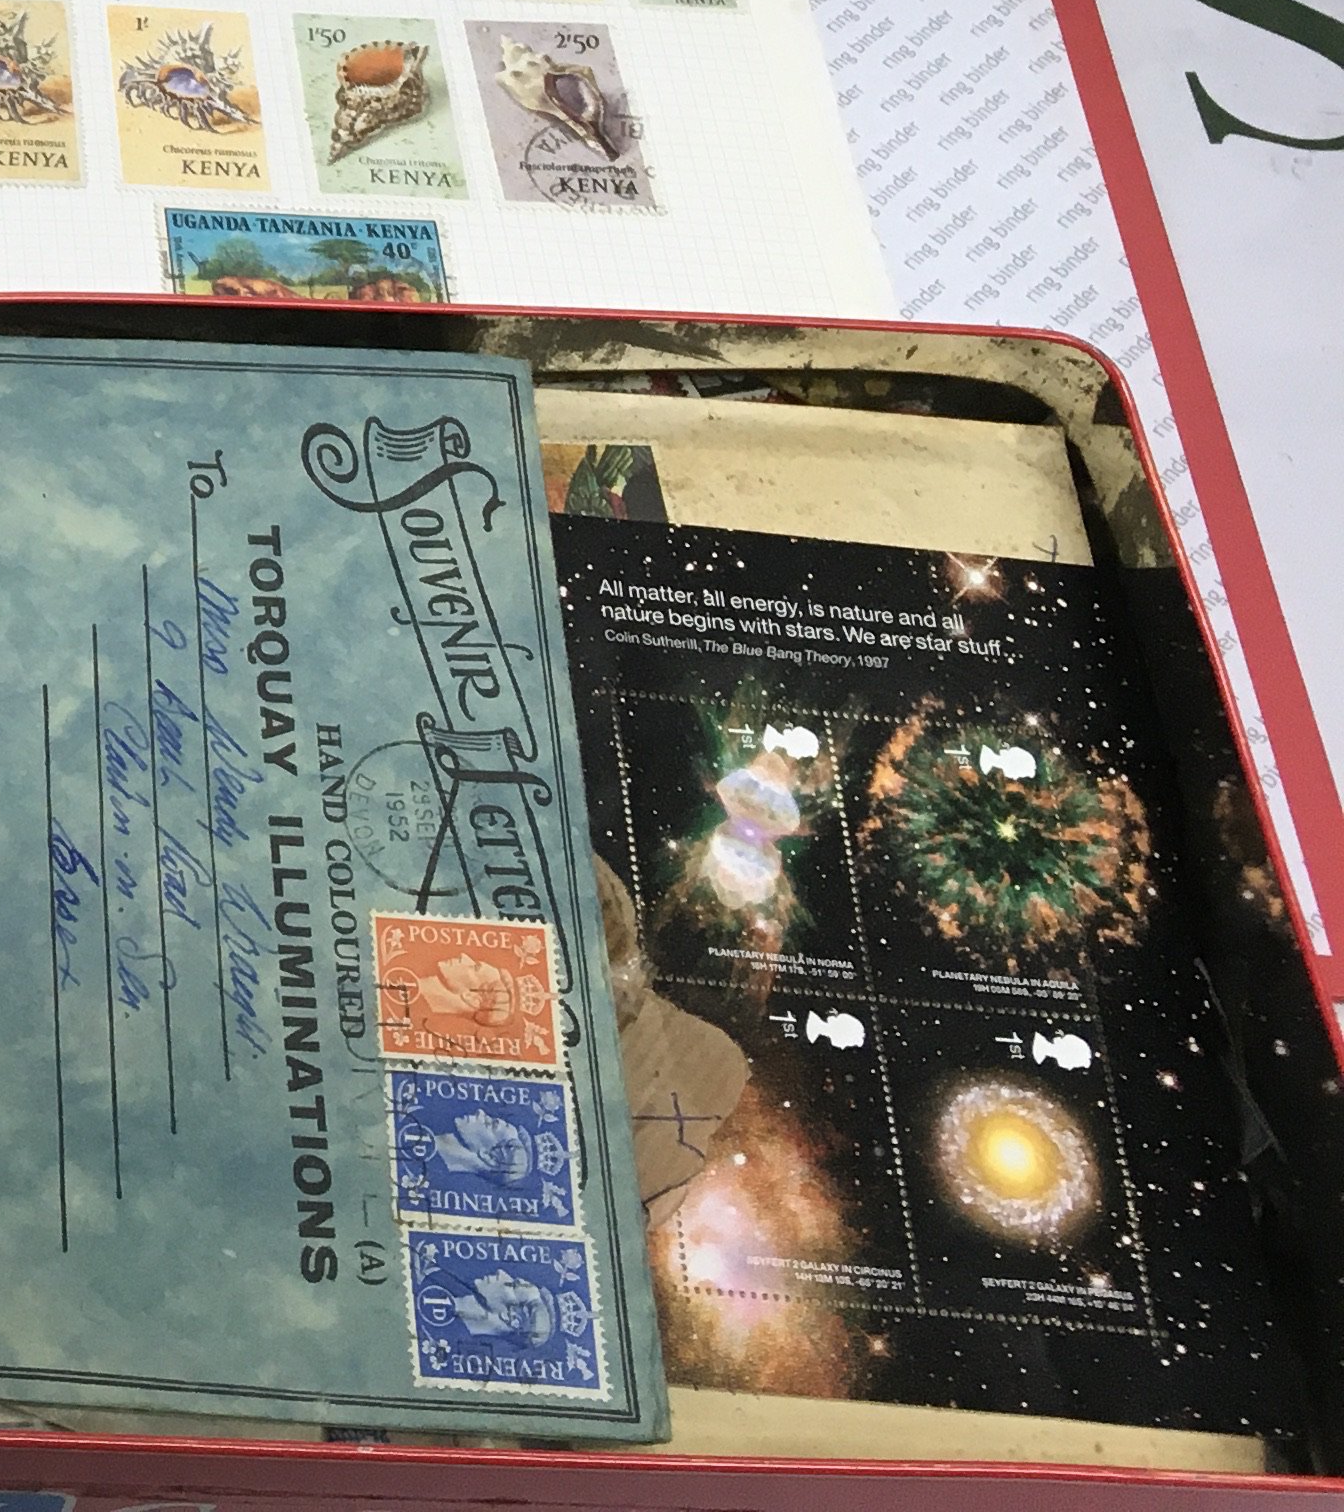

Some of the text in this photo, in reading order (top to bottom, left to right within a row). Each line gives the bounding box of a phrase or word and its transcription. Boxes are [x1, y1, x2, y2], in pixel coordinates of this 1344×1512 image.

[937, 88, 1010, 152] ring binder
[181, 160, 261, 179] KENYA
[172, 213, 434, 240] UGANDA TANZANIA KENYA
[904, 204, 978, 271] ring binder
[187, 451, 228, 499] To
[599, 578, 964, 631] All matter, all energy, is nature and all
[602, 605, 665, 626] nature
[669, 609, 735, 633] begins
[740, 615, 781, 636] with
[786, 622, 840, 642] stars.
[843, 626, 876, 646] We
[880, 632, 911, 650] are
[915, 633, 952, 653] star
[605, 629, 640, 646] Colin
[703, 639, 729, 654] The
[732, 643, 763, 658] Blue
[766, 646, 802, 664] Bang
[805, 650, 855, 669] Theory,
[857, 654, 890, 669] 1997
[727, 724, 755, 750] 1st
[150, 618, 213, 931] 9 Road
[204, 712, 263, 848] Wendy
[316, 722, 348, 824] HAND
[386, 791, 410, 843] 1952
[50, 817, 100, 990] Essex
[246, 525, 338, 1285] TORQUAY ILLUMINATIONS
[324, 838, 366, 1040] COLOURED
[408, 925, 513, 950] POSTAGE
[708, 947, 764, 961] PLANETARY
[766, 953, 805, 966] NEBULA
[806, 957, 815, 967] IN
[817, 958, 854, 971] NORMA
[414, 1030, 521, 1057] REVENUE
[769, 1010, 798, 1039] 1st
[424, 1080, 531, 1106] POSTAGE
[429, 1188, 539, 1218] REVENUE
[354, 1239, 387, 1286] (A)
[441, 1239, 552, 1266] POSTAGE
[451, 1353, 565, 1382] REVENUE
